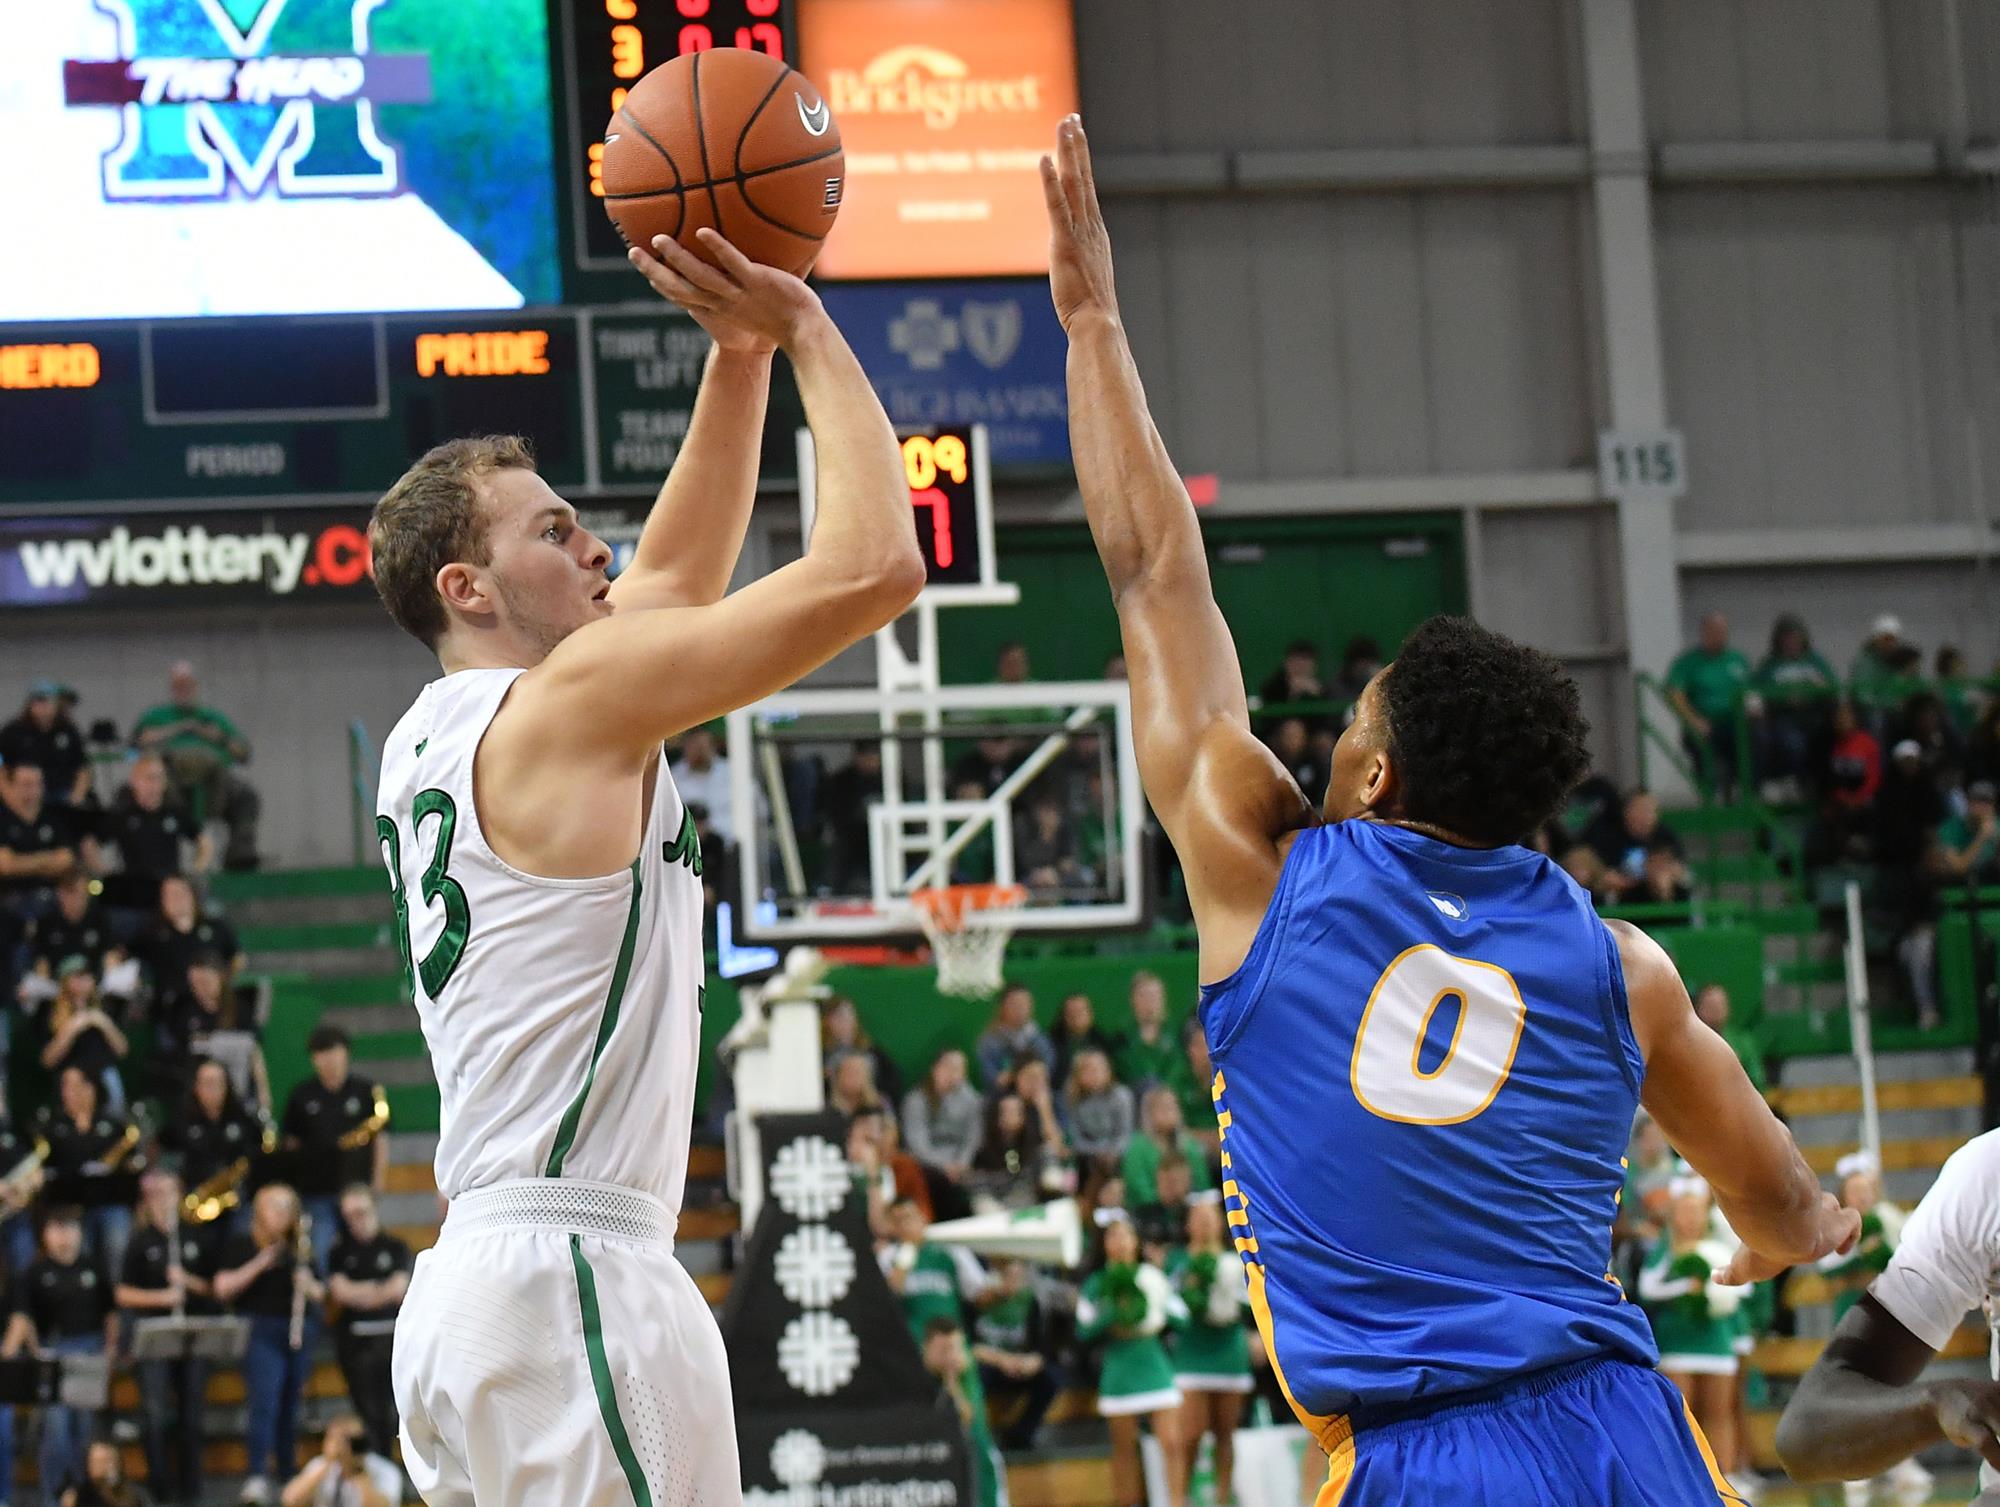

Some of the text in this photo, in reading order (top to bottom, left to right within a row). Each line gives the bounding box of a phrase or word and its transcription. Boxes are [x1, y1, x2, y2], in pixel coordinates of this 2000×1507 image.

[416, 330, 550, 378] PRIDE
[1615, 442, 1677, 486] 115
[1350, 943, 1526, 1126] 0
